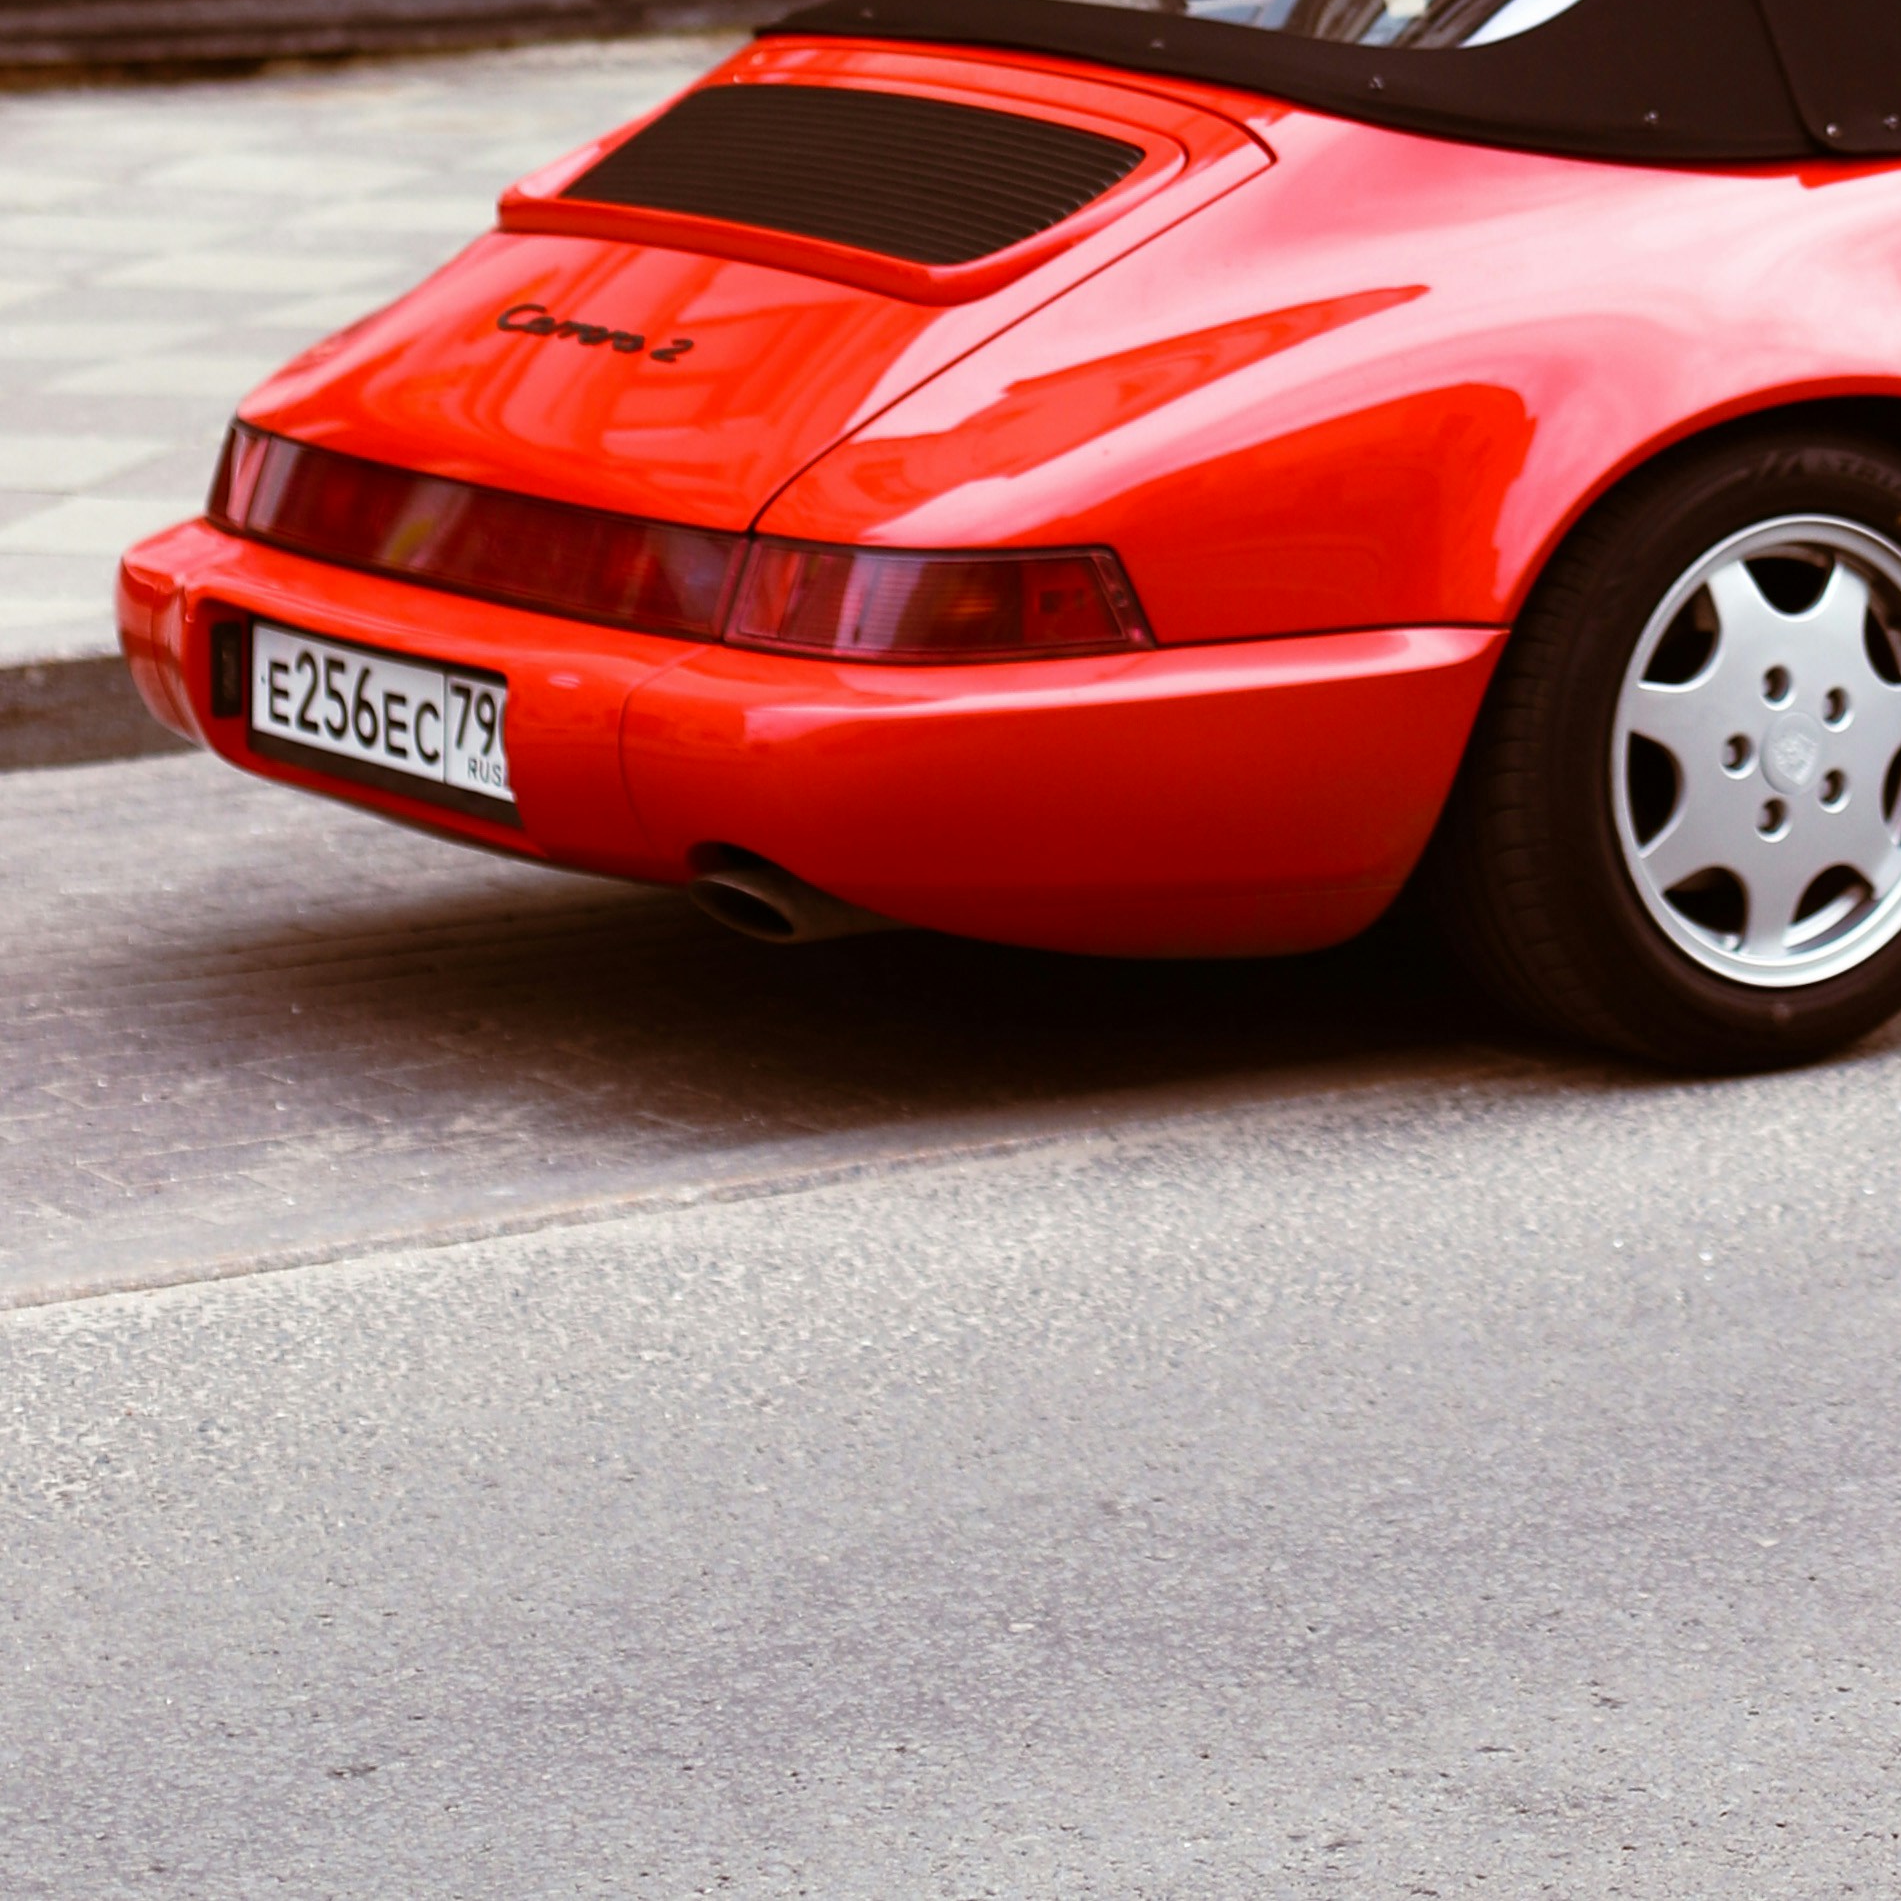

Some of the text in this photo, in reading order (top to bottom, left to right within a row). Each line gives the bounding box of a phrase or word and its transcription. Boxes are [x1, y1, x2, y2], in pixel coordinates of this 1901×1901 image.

[650, 337, 694, 363] 2
[449, 683, 505, 757] 79
[468, 758, 503, 787] RUS
